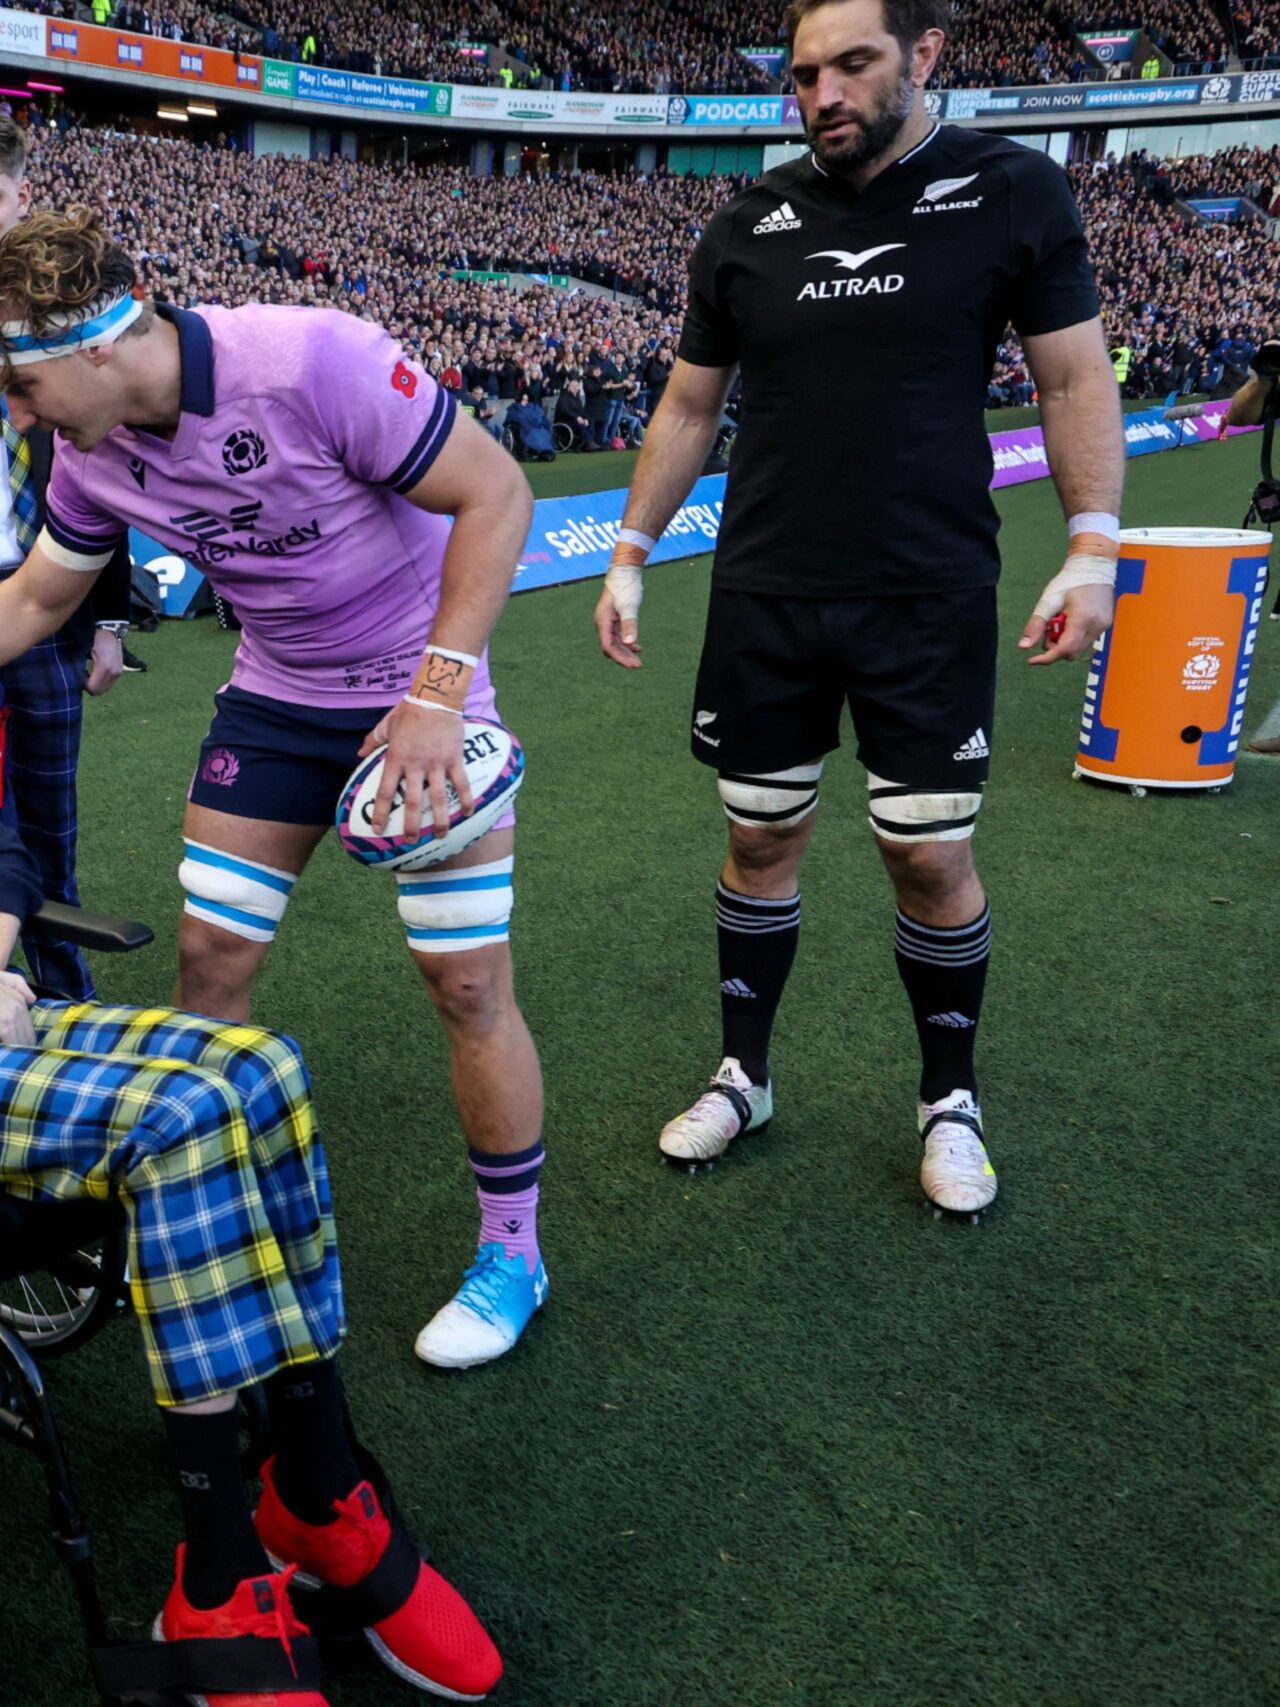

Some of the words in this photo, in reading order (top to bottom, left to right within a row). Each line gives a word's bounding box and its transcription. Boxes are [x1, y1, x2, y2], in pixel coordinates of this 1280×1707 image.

[298, 70, 316, 86] Play
[322, 74, 346, 88] Coach
[352, 79, 383, 94] Referee
[388, 84, 429, 98] Volunteer
[949, 90, 991, 100] JUNIOR
[1023, 96, 1050, 108] JOIN
[1053, 94, 1083, 106] NOW
[1088, 87, 1196, 104] scottishrugby.org
[1238, 91, 1274, 102] CLUB
[508, 101, 555, 110] FAIRWAYS
[615, 106, 666, 114] FAIRWAYS
[947, 97, 1019, 109] SUPPORTERS
[694, 102, 780, 120] PODCAST
[946, 109, 976, 118] CLUB
[912, 205, 933, 214] ALL
[934, 199, 980, 212] BLACKS
[753, 218, 802, 234] adidas
[796, 274, 905, 301] ALTRAD
[953, 747, 989, 761] adidas
